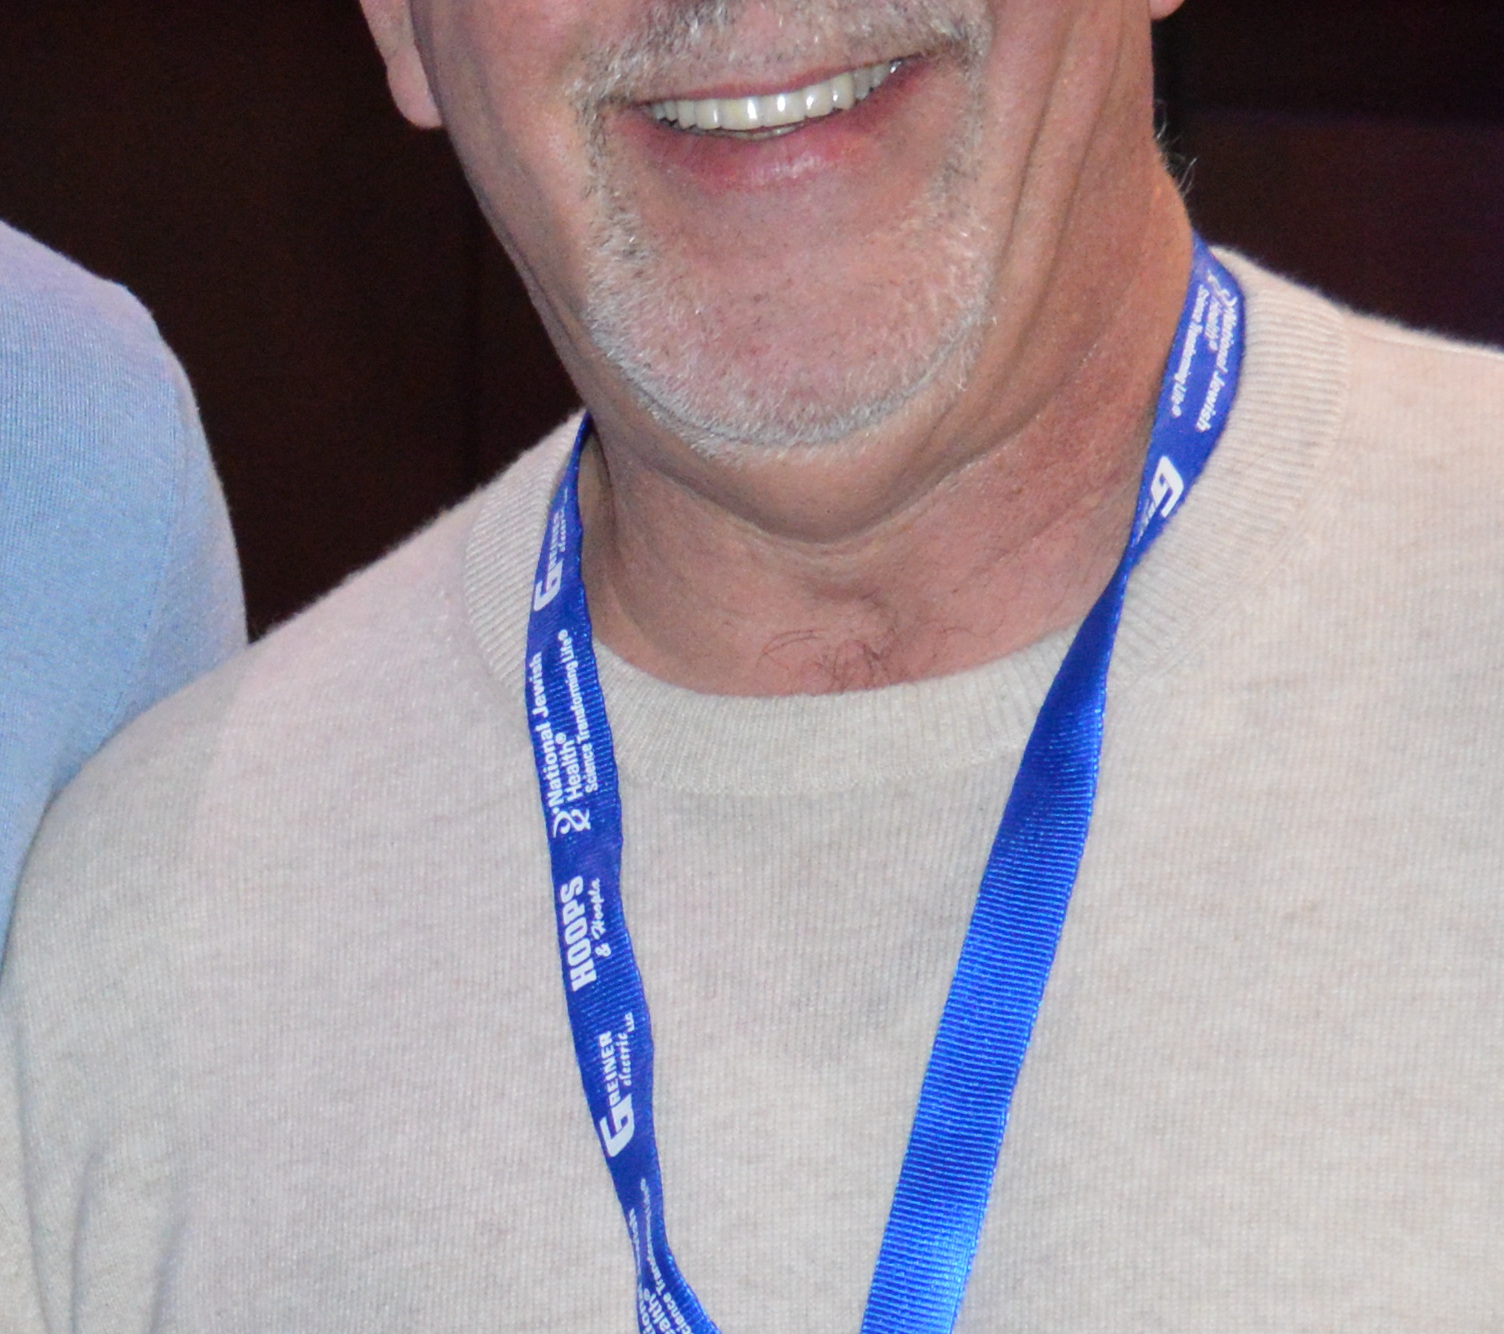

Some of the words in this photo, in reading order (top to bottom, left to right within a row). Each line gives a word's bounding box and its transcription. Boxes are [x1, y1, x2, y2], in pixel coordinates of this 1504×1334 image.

[529, 651, 550, 719] Jewish
[565, 659, 591, 745] Transforming
[535, 720, 565, 810] National
[581, 743, 599, 794] Science
[560, 875, 598, 993] HOOPS
